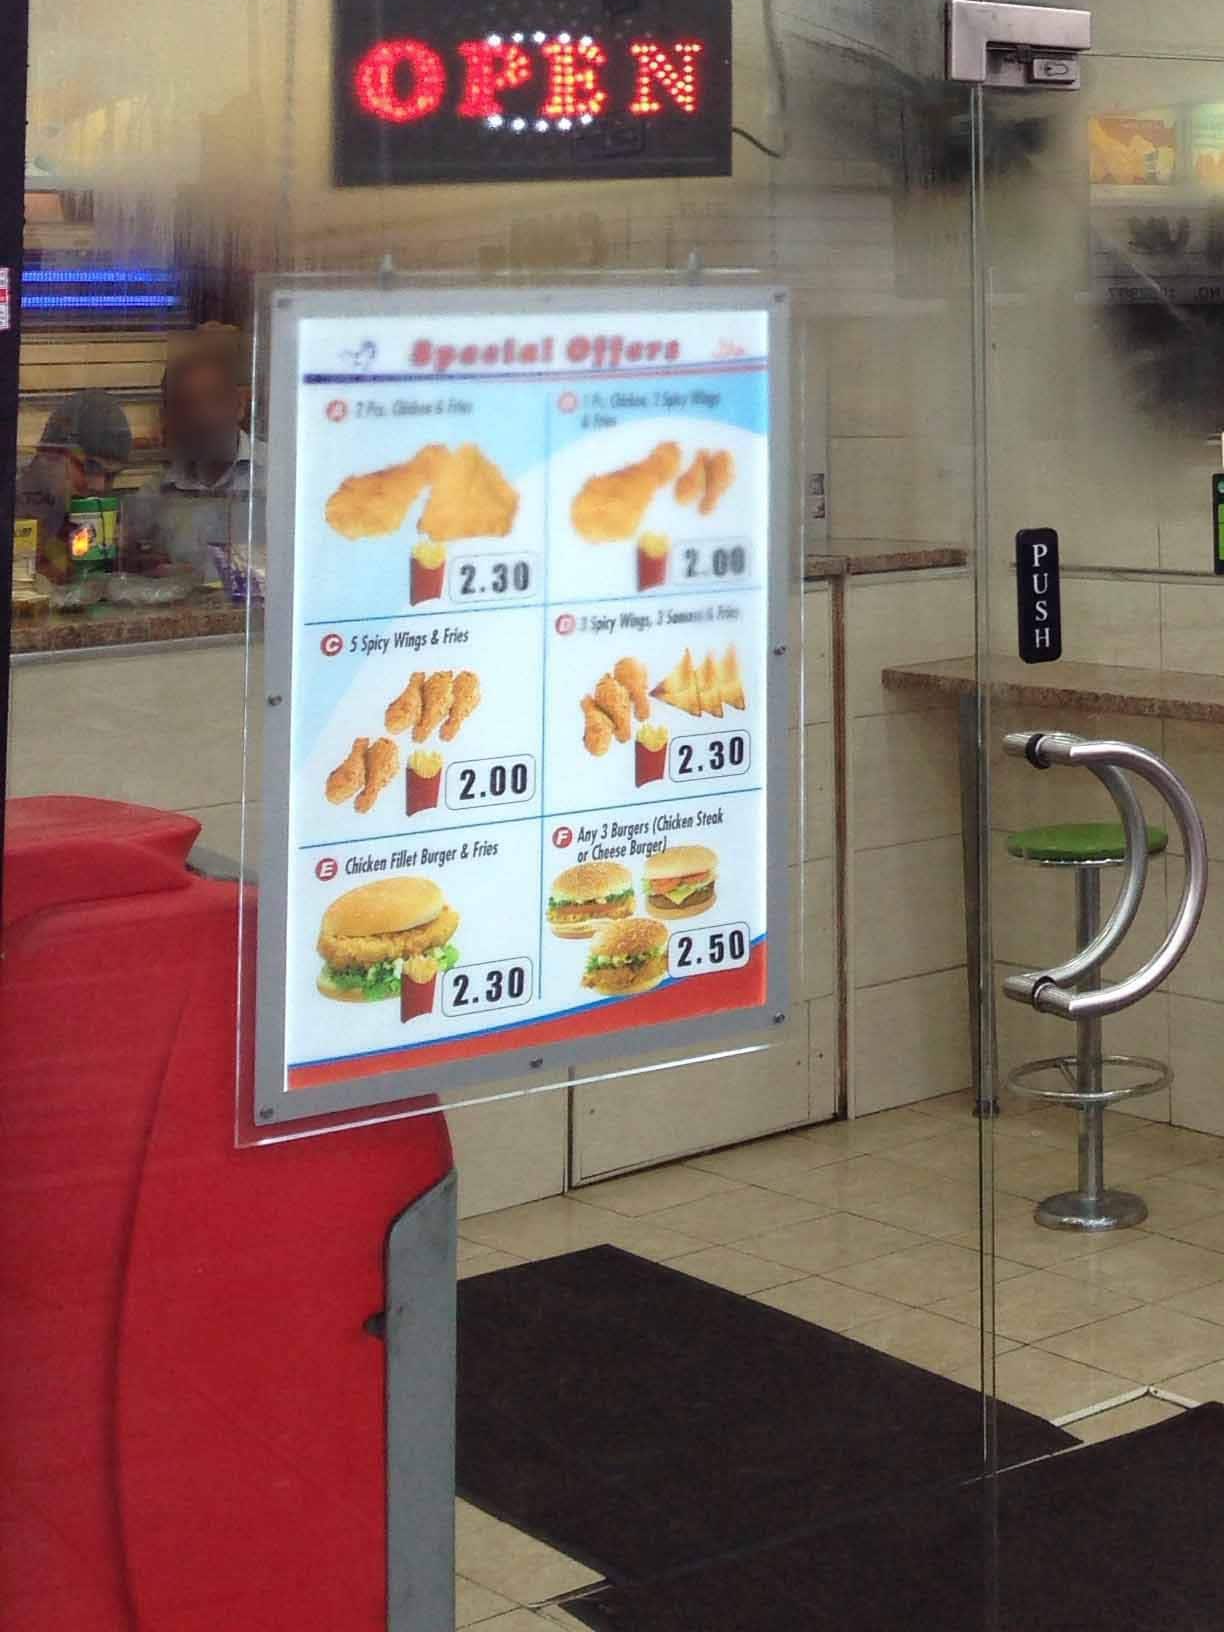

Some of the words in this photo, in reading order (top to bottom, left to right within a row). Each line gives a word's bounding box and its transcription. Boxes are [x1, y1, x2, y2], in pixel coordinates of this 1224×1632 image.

[353, 36, 702, 123] OPEN
[410, 336, 554, 372] Special
[565, 335, 680, 368] Offers
[460, 562, 530, 596] 2.30
[684, 545, 746, 579] 2.00
[1032, 543, 1050, 648] PUSH
[350, 636, 357, 653] 5
[361, 634, 390, 656] Spicy
[394, 631, 427, 652] Wings
[430, 629, 439, 645] &
[443, 627, 469, 644] Fries
[678, 737, 744, 775] 2.30
[459, 764, 528, 800] 2.00
[577, 826, 597, 844] Any
[601, 824, 608, 839] 3
[611, 820, 649, 840] Burgers
[653, 814, 693, 835] (Chicken
[697, 808, 724, 826] Steak
[345, 855, 386, 875] Chicken
[390, 849, 418, 869] Fillet
[421, 847, 457, 868] Burger
[460, 843, 468, 858] &
[472, 841, 499, 857] Fries
[577, 850, 588, 862] or
[592, 843, 626, 861] Cheese
[629, 836, 667, 858] Burger)
[677, 929, 745, 968] 2.50
[452, 968, 525, 1007] 2.30
